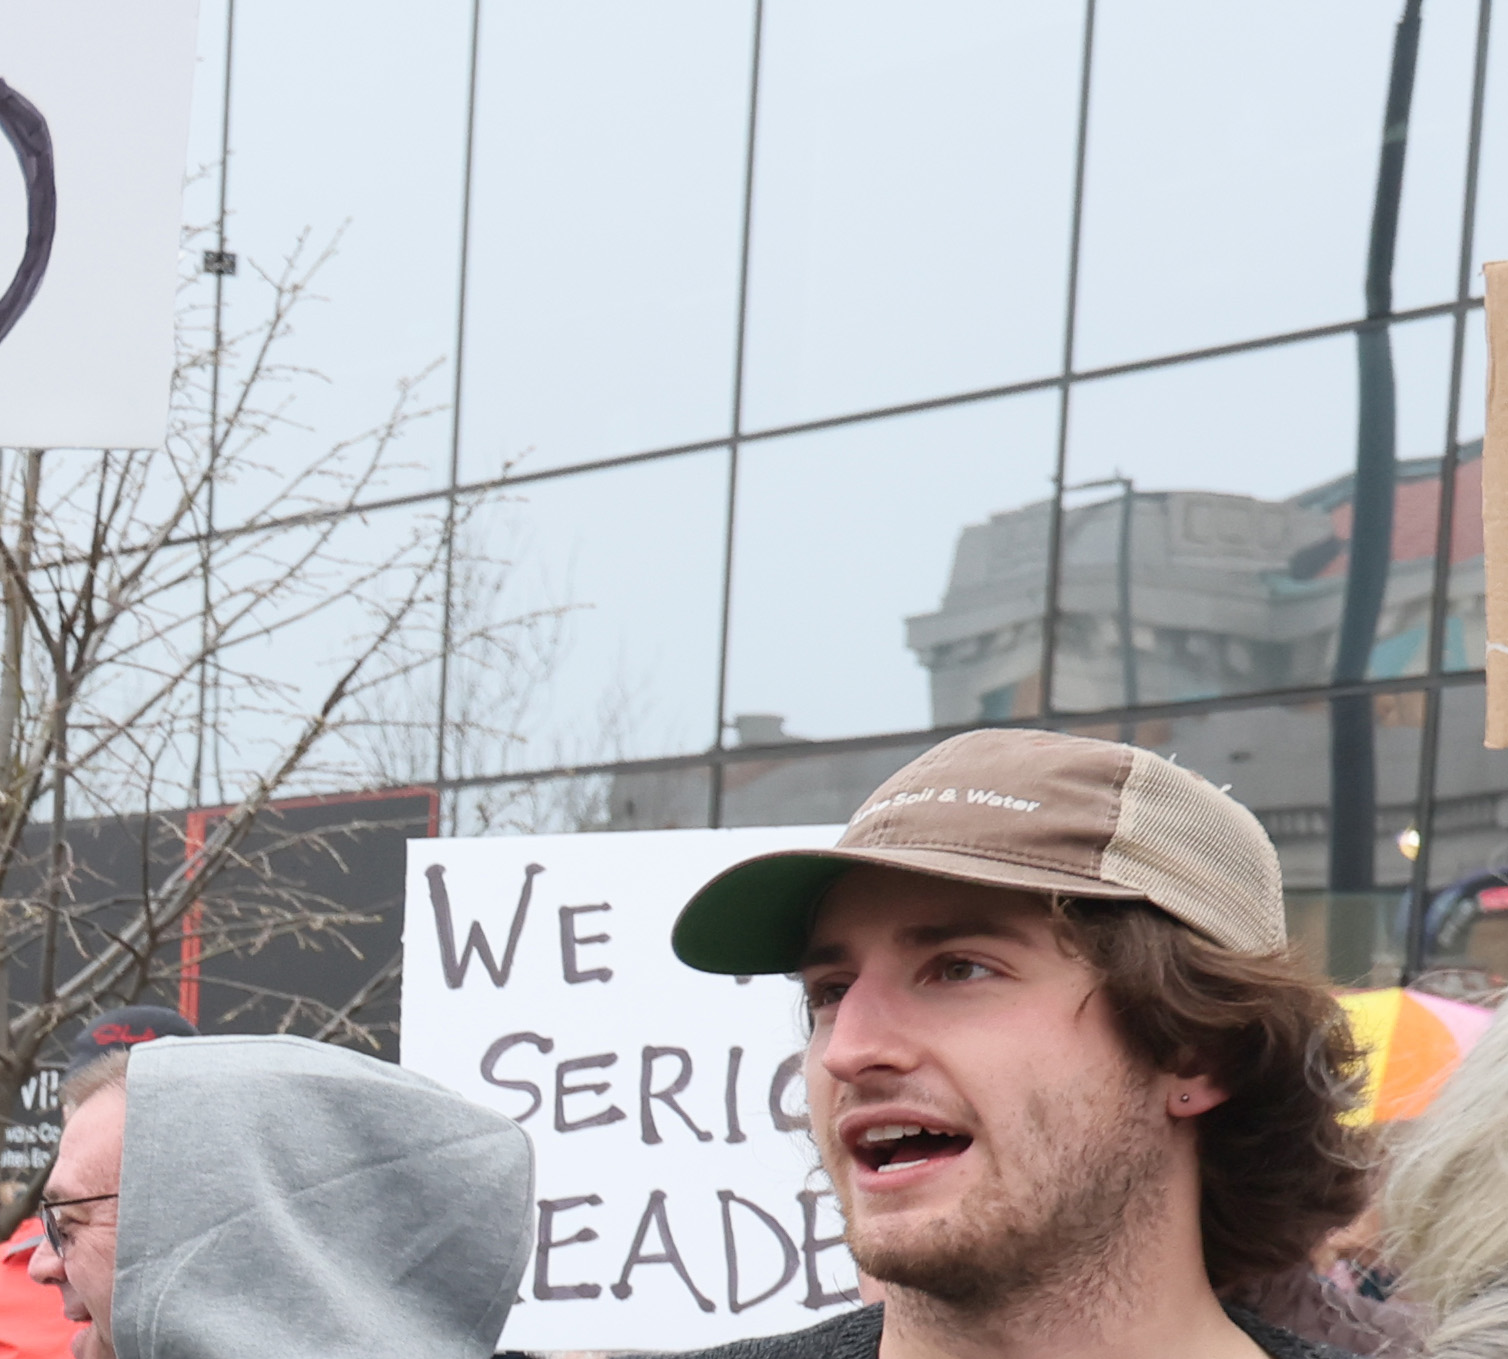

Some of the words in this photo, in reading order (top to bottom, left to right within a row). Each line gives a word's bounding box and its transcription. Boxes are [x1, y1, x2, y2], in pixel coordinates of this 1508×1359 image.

[889, 787, 935, 807] Soil
[937, 787, 958, 804] &
[966, 787, 1041, 813] Water
[424, 862, 614, 990] WE
[514, 1188, 861, 1314] EADE
